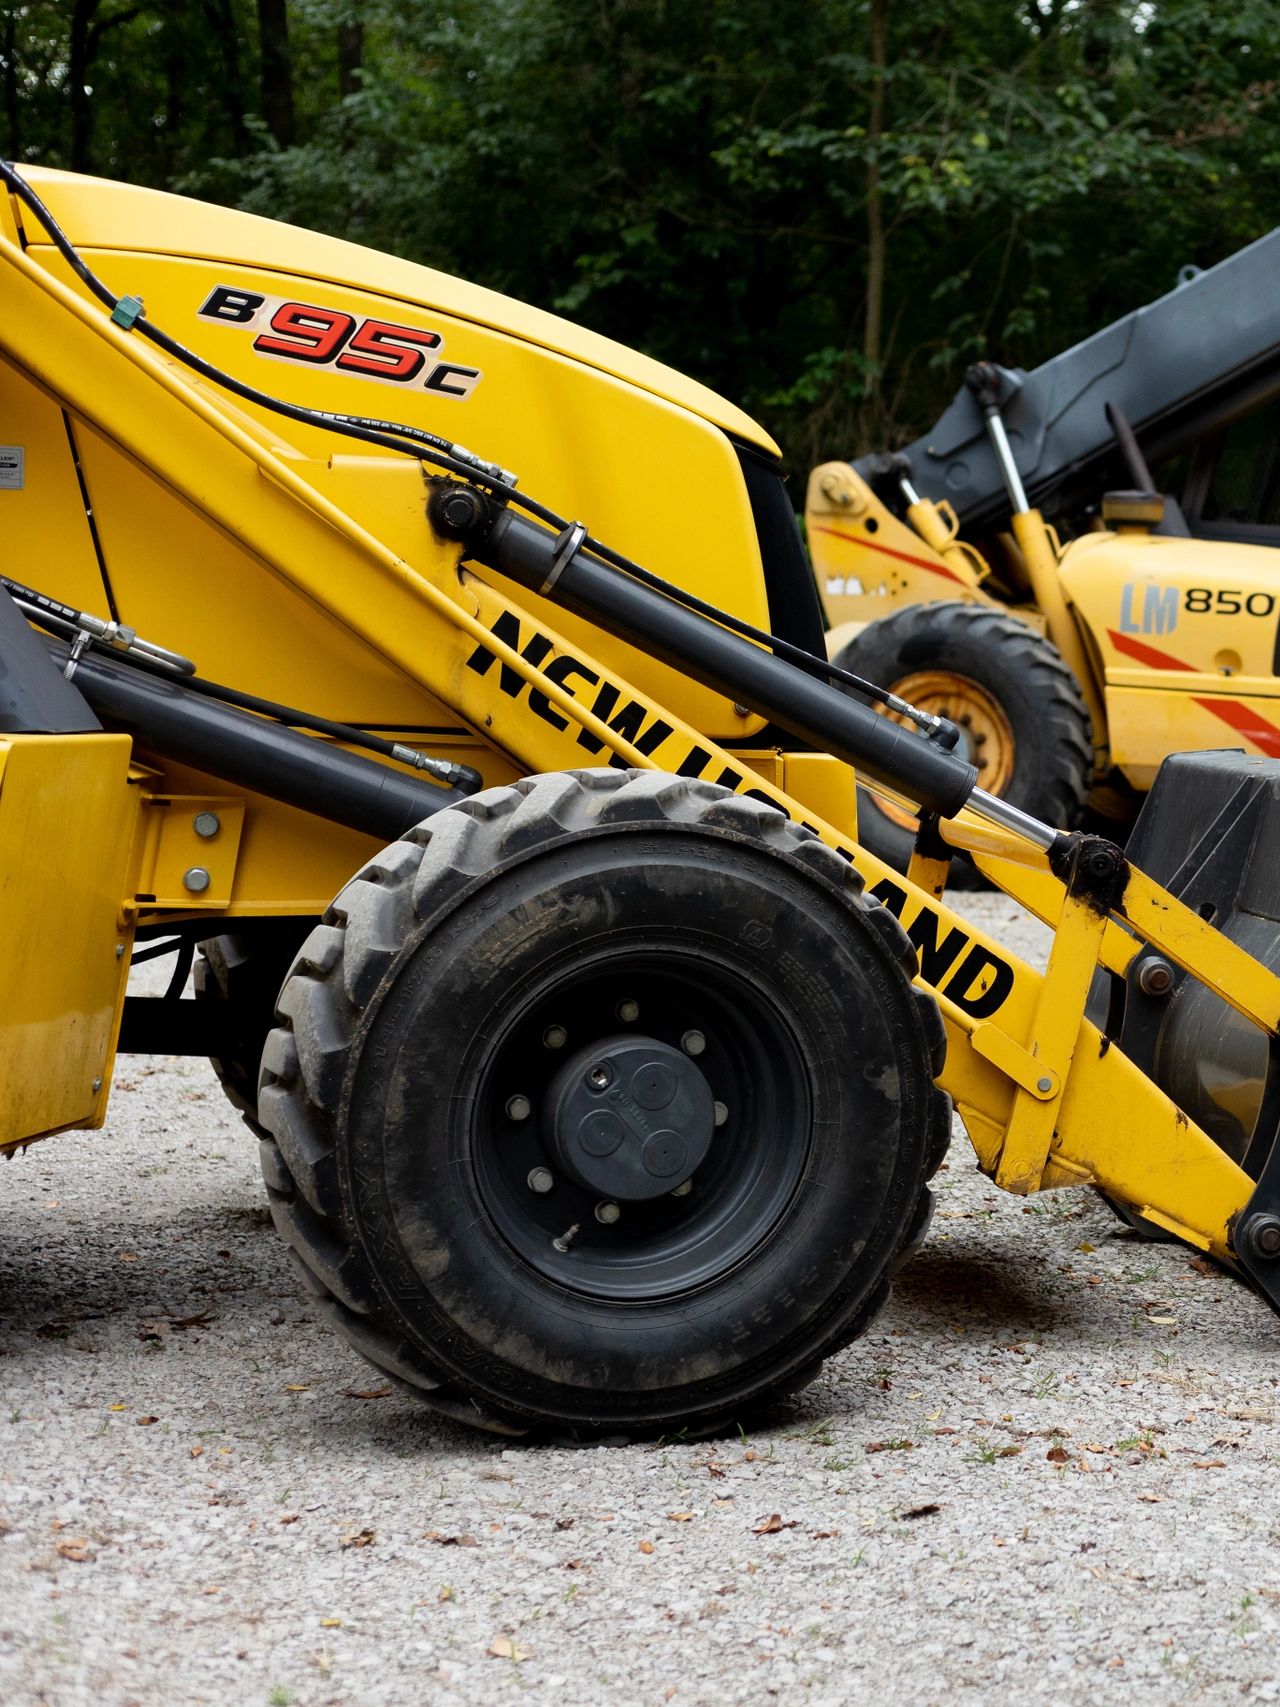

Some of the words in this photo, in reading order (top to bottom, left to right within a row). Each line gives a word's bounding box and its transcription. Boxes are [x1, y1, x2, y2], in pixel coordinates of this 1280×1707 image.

[1119, 583, 1179, 635] LM
[1184, 588, 1276, 617] 850
[466, 609, 674, 770] NEW
